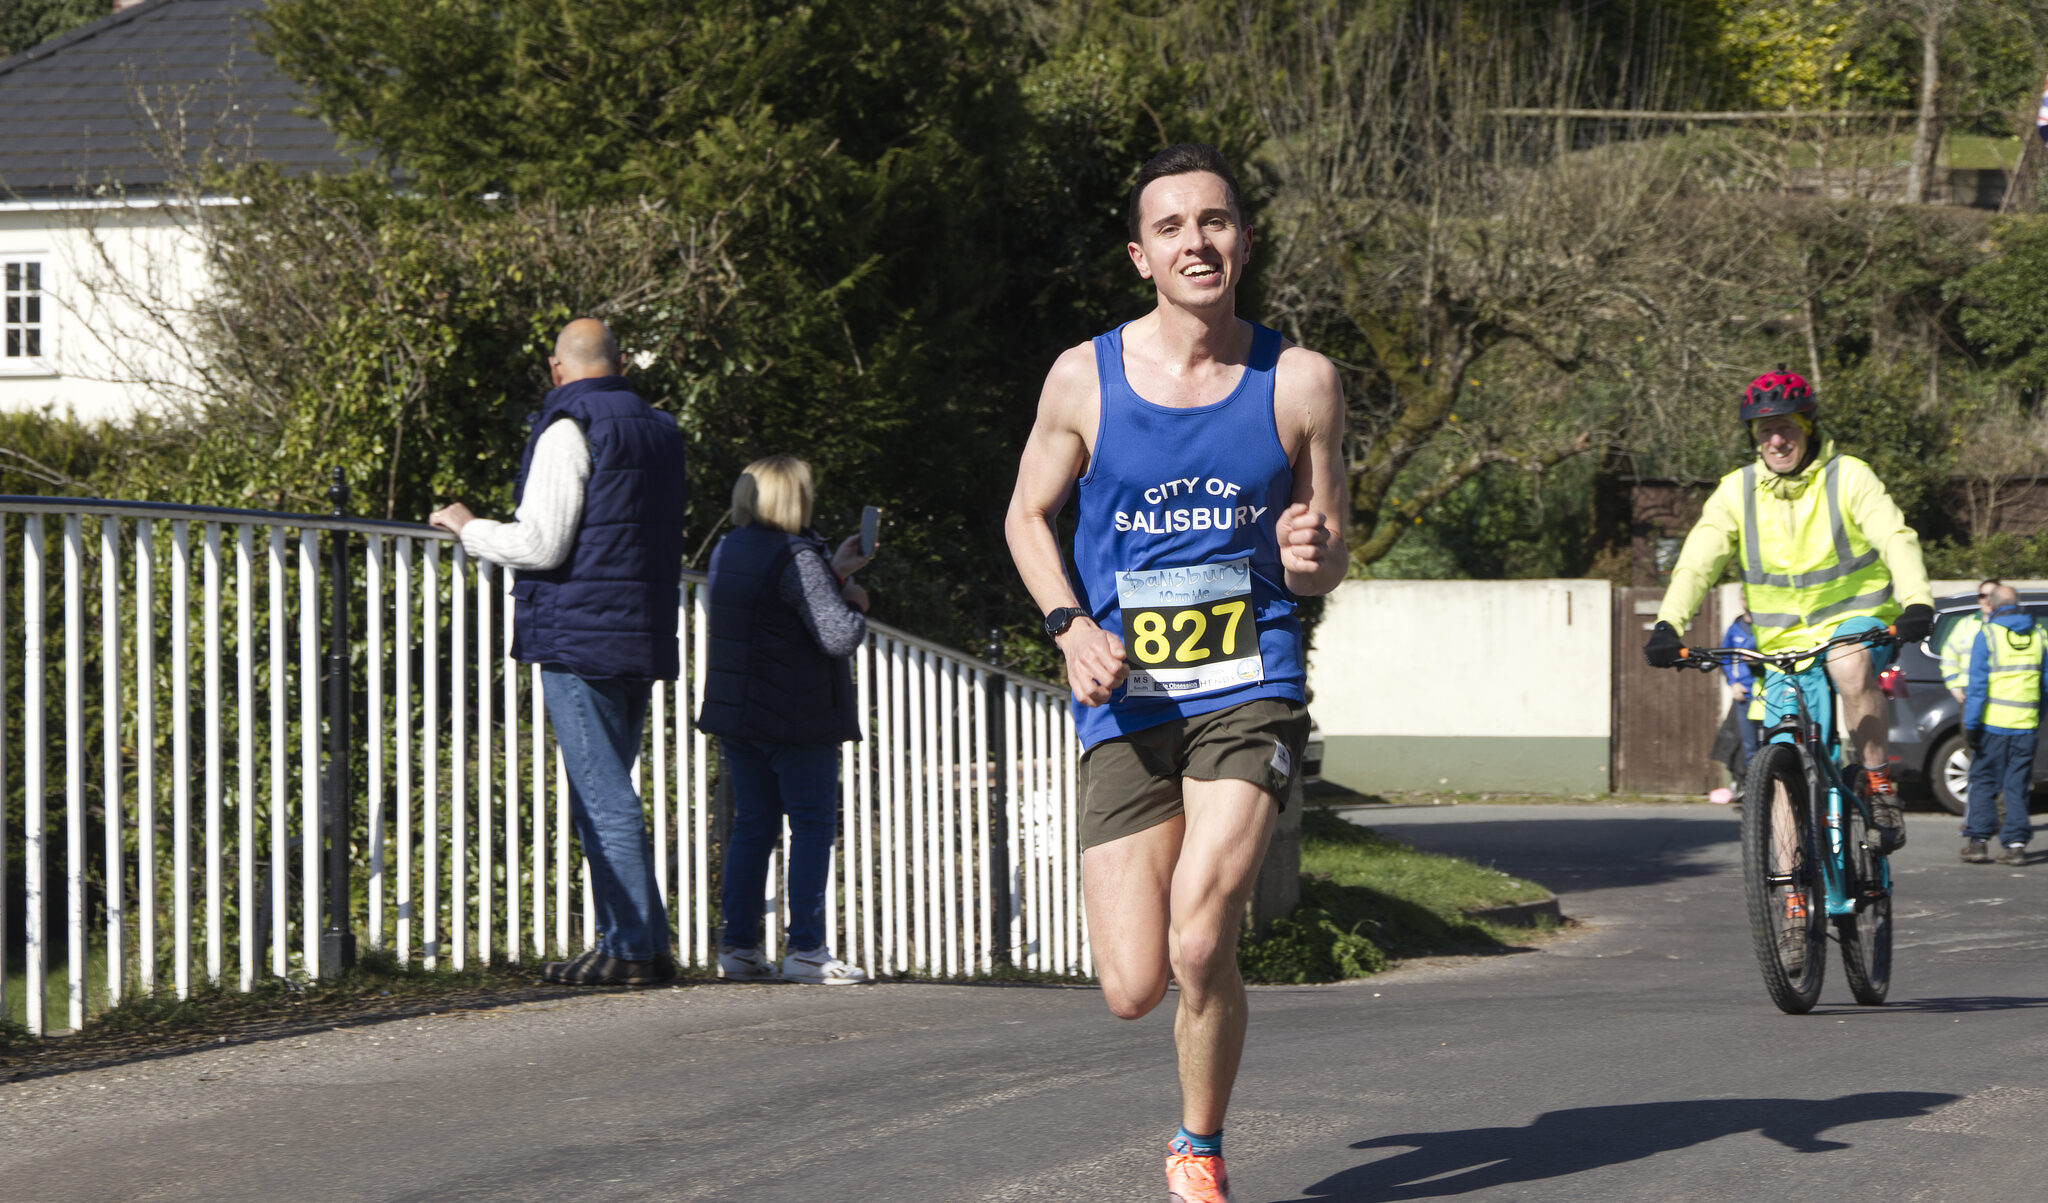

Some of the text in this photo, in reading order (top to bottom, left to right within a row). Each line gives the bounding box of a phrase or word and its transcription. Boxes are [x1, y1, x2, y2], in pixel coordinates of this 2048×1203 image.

[1144, 477, 1241, 504] CITY OF
[1115, 505, 1268, 534] SALISBURY
[1122, 562, 1249, 598] Salisbury
[1133, 601, 1246, 664] 827
